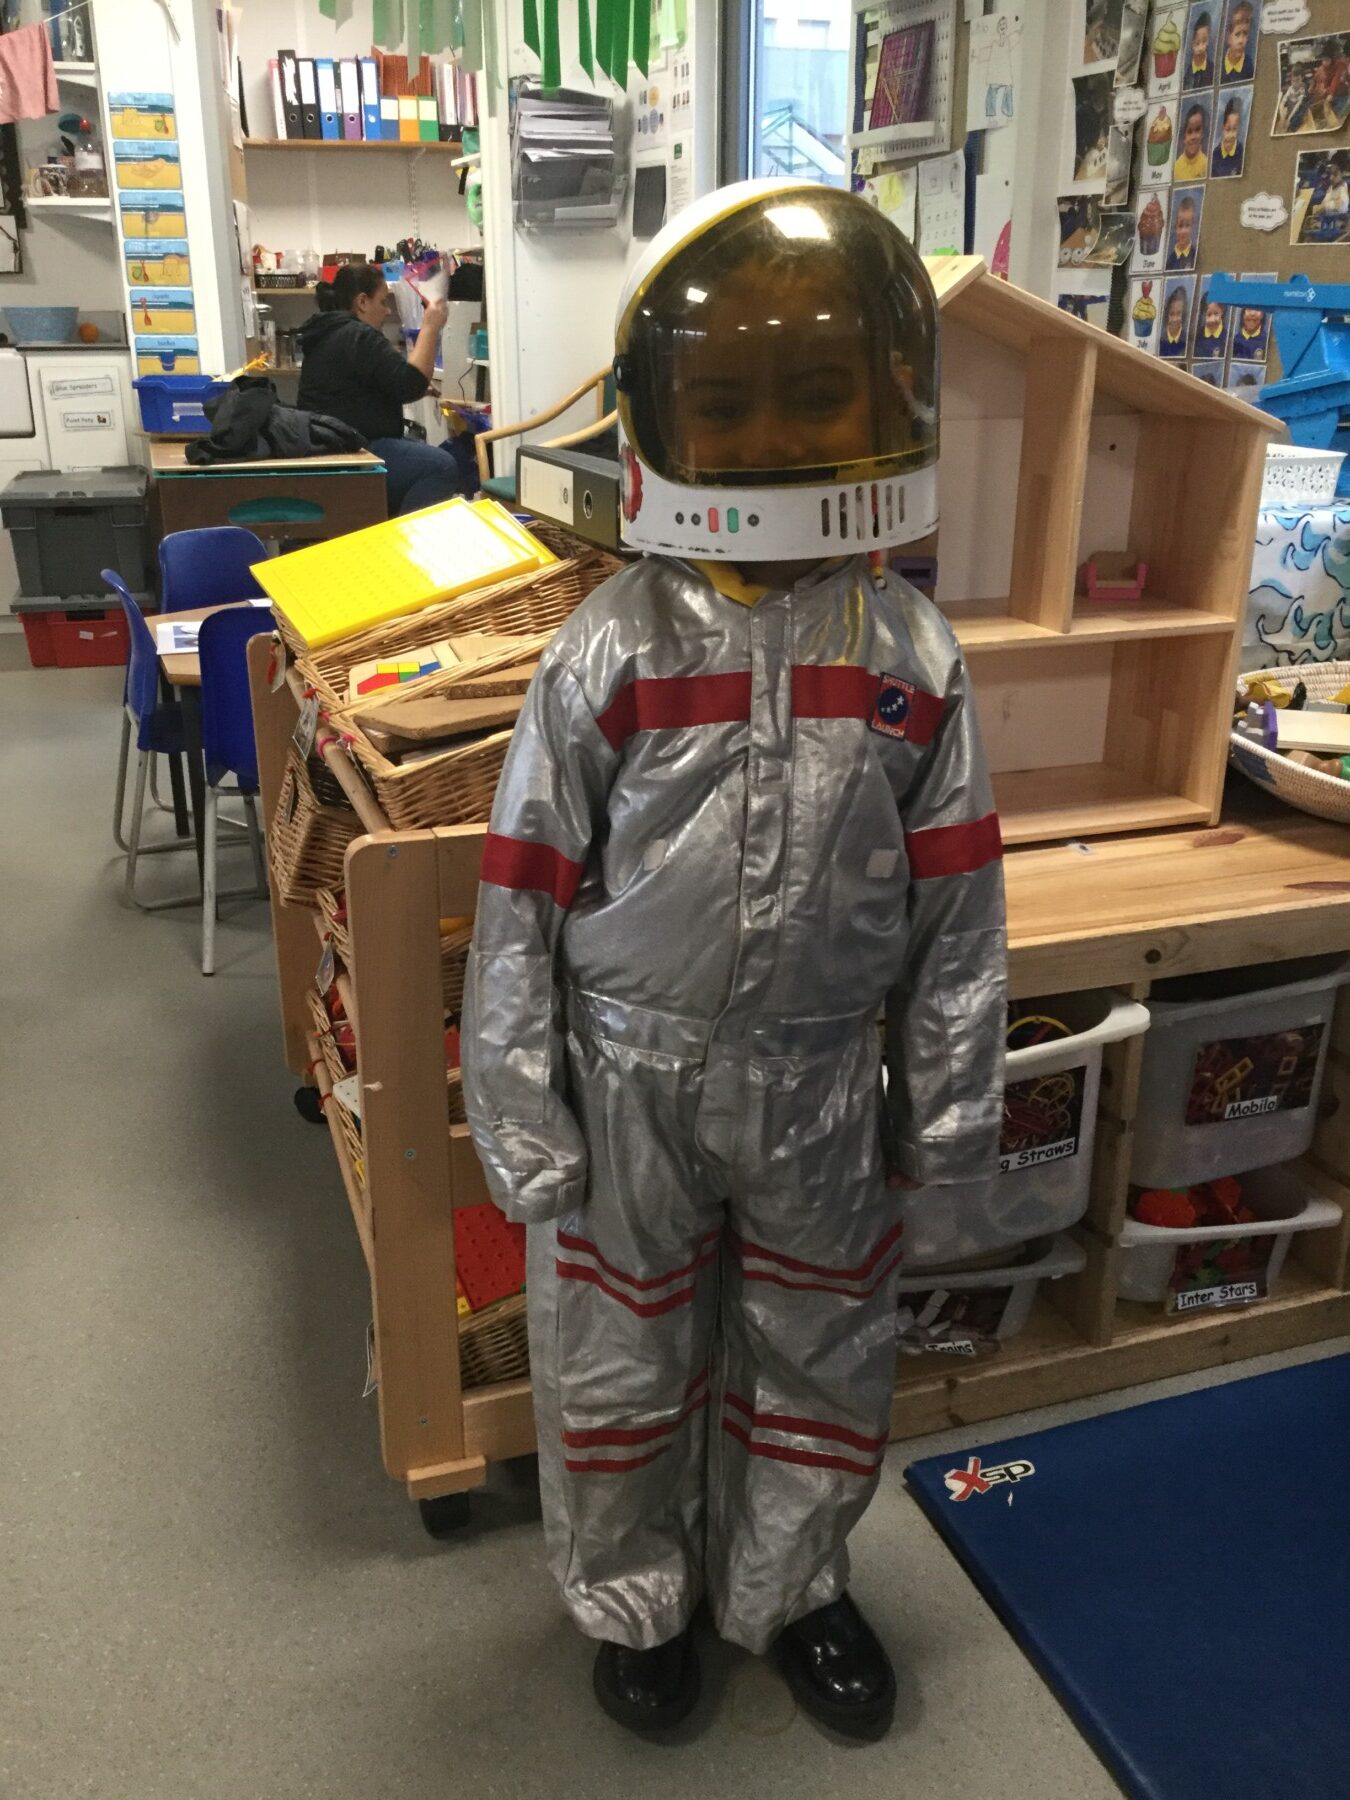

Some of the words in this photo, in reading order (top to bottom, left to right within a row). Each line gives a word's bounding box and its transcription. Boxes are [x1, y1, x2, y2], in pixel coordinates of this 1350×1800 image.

[1158, 81, 1171, 93] April
[1151, 170, 1163, 180] May
[1228, 1098, 1276, 1117] Mobilo
[1017, 1141, 1073, 1166] Straws
[1180, 1291, 1214, 1307] Inter
[1218, 1284, 1256, 1299] Stars
